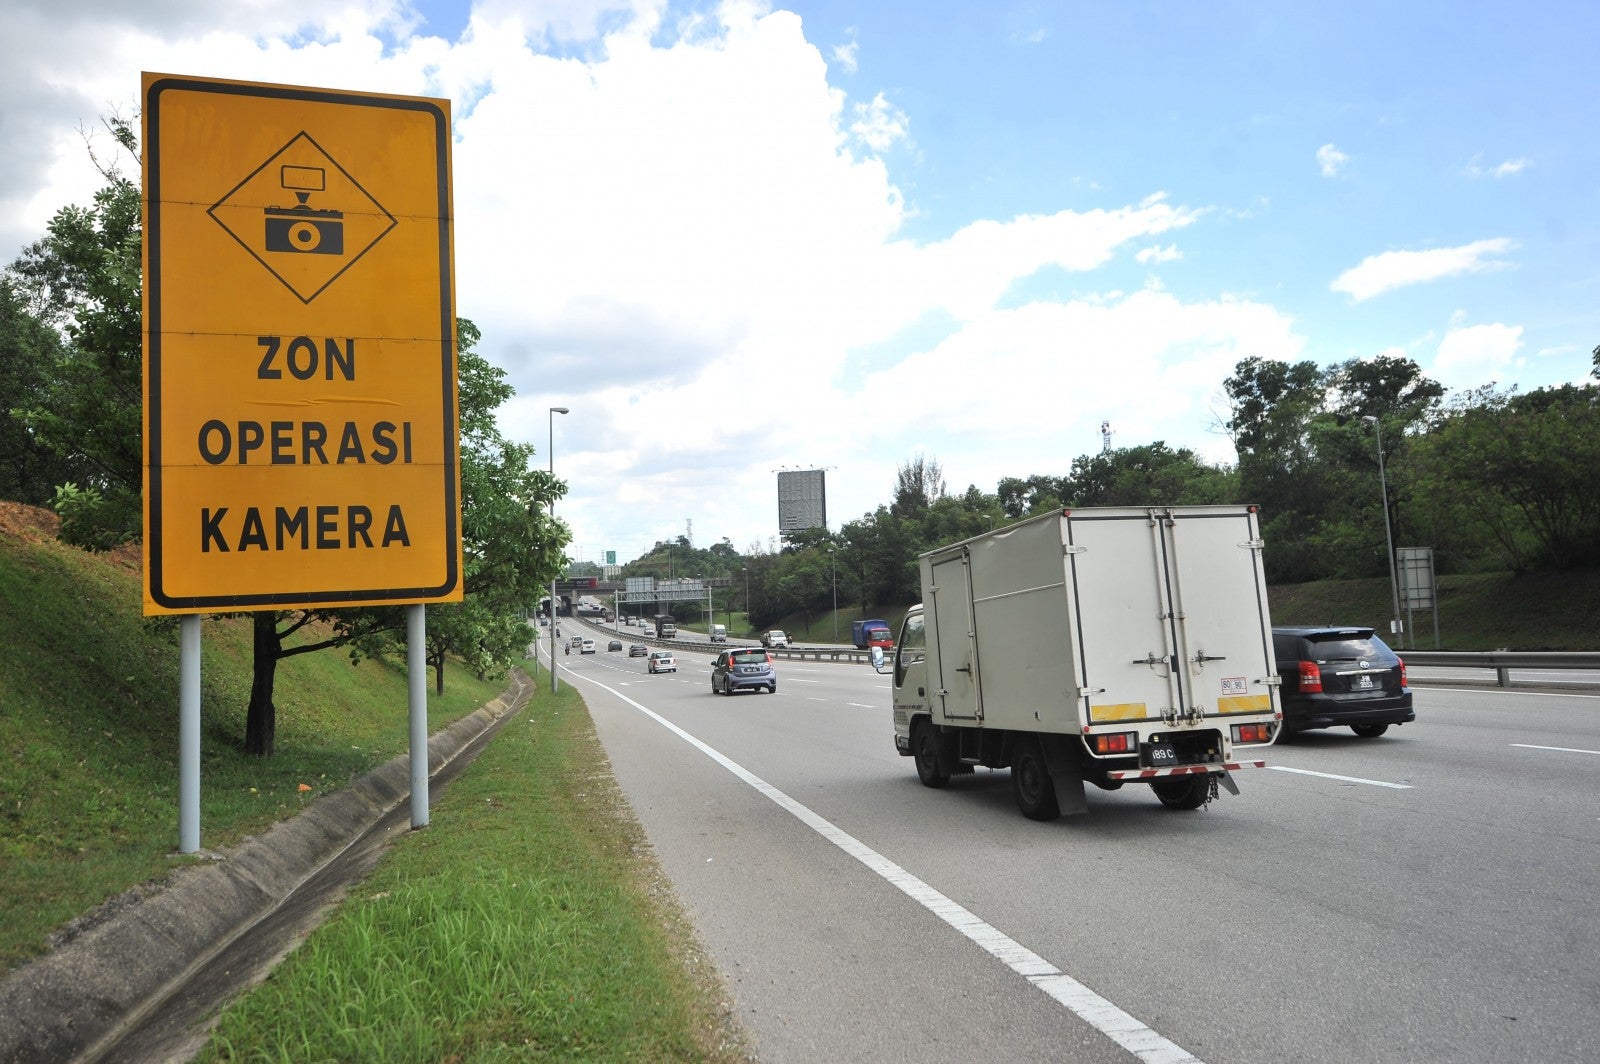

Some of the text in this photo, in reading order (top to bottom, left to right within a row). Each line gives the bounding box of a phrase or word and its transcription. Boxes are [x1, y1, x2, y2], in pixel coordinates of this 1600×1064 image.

[257, 335, 355, 381] ZON
[197, 419, 412, 465] OPERASI
[201, 504, 411, 553] KAMERA
